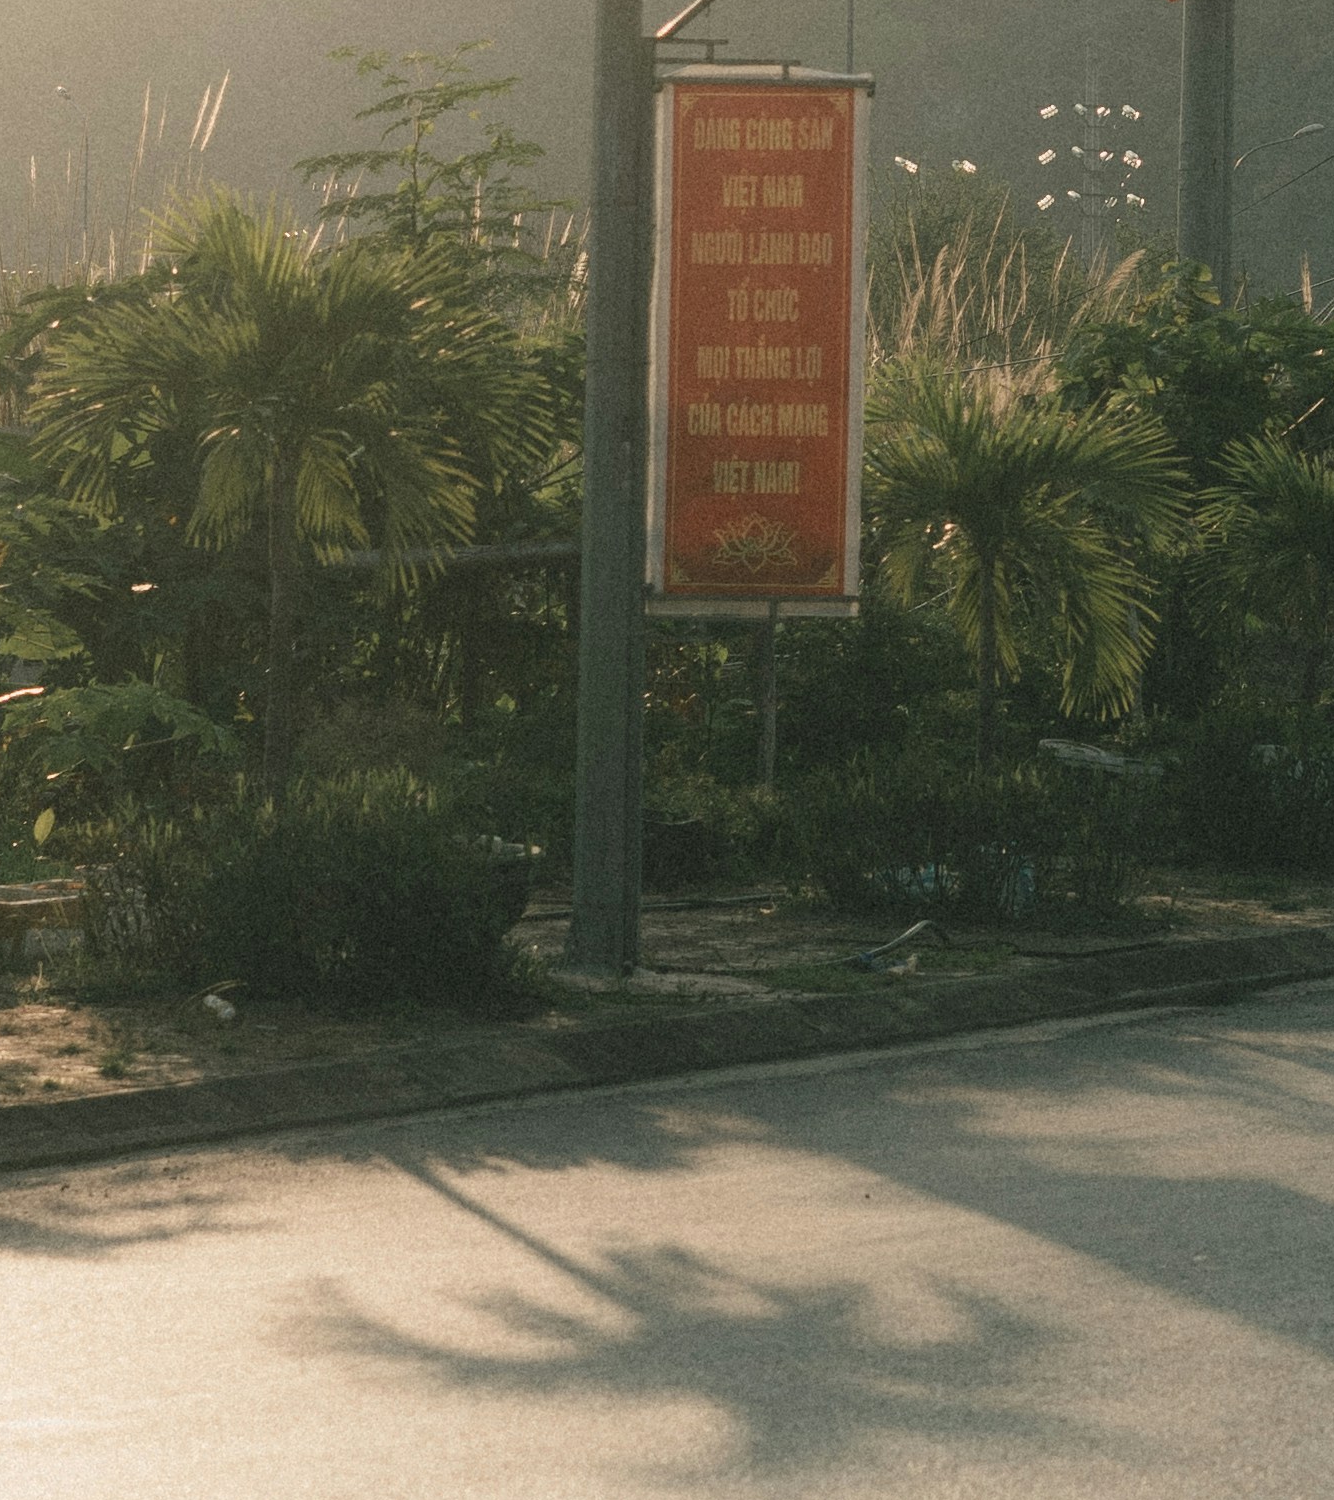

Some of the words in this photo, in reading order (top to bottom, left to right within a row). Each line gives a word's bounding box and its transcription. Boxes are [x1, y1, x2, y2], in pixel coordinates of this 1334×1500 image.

[722, 168, 758, 215] VIỆT
[763, 175, 804, 208] NAM
[726, 396, 773, 436] CÁCH
